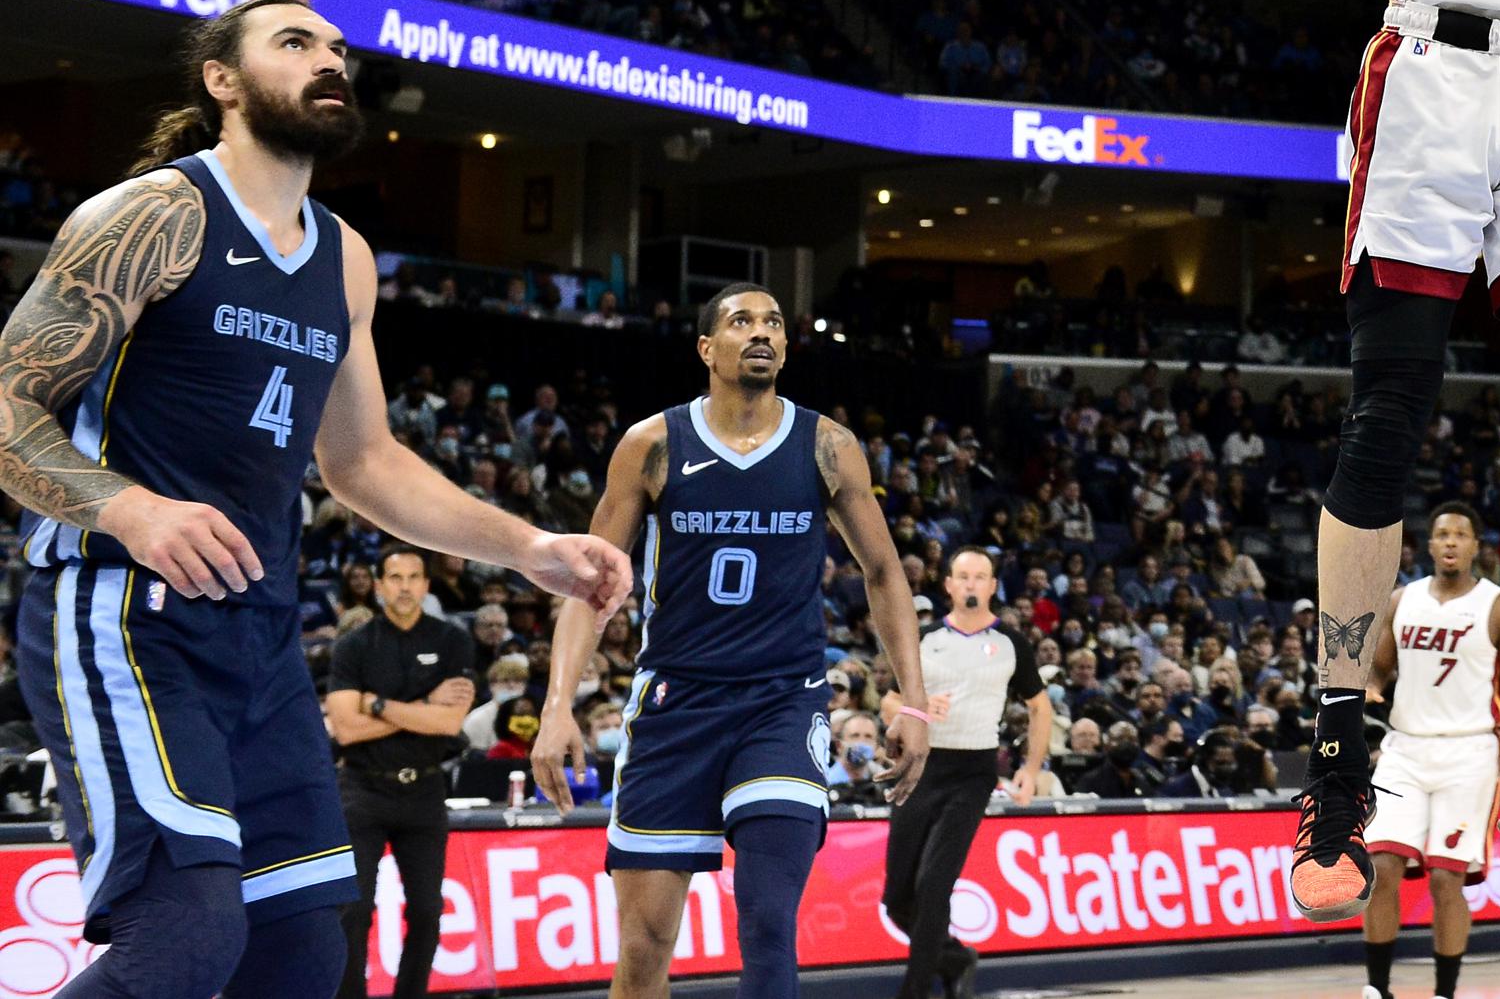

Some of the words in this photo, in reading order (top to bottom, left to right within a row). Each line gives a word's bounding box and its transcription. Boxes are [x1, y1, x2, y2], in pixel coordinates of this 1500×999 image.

[379, 8, 465, 69] Apply
[469, 32, 501, 70] at
[504, 42, 810, 130] www.fedexishiring.com
[1013, 110, 1148, 167] FedEx
[213, 303, 338, 364] GRIZZLIES
[248, 365, 294, 448] 4
[671, 510, 813, 534] GRIZZLIES
[707, 547, 758, 606] 0
[1400, 624, 1475, 653] HEAT
[1432, 657, 1459, 688] 7
